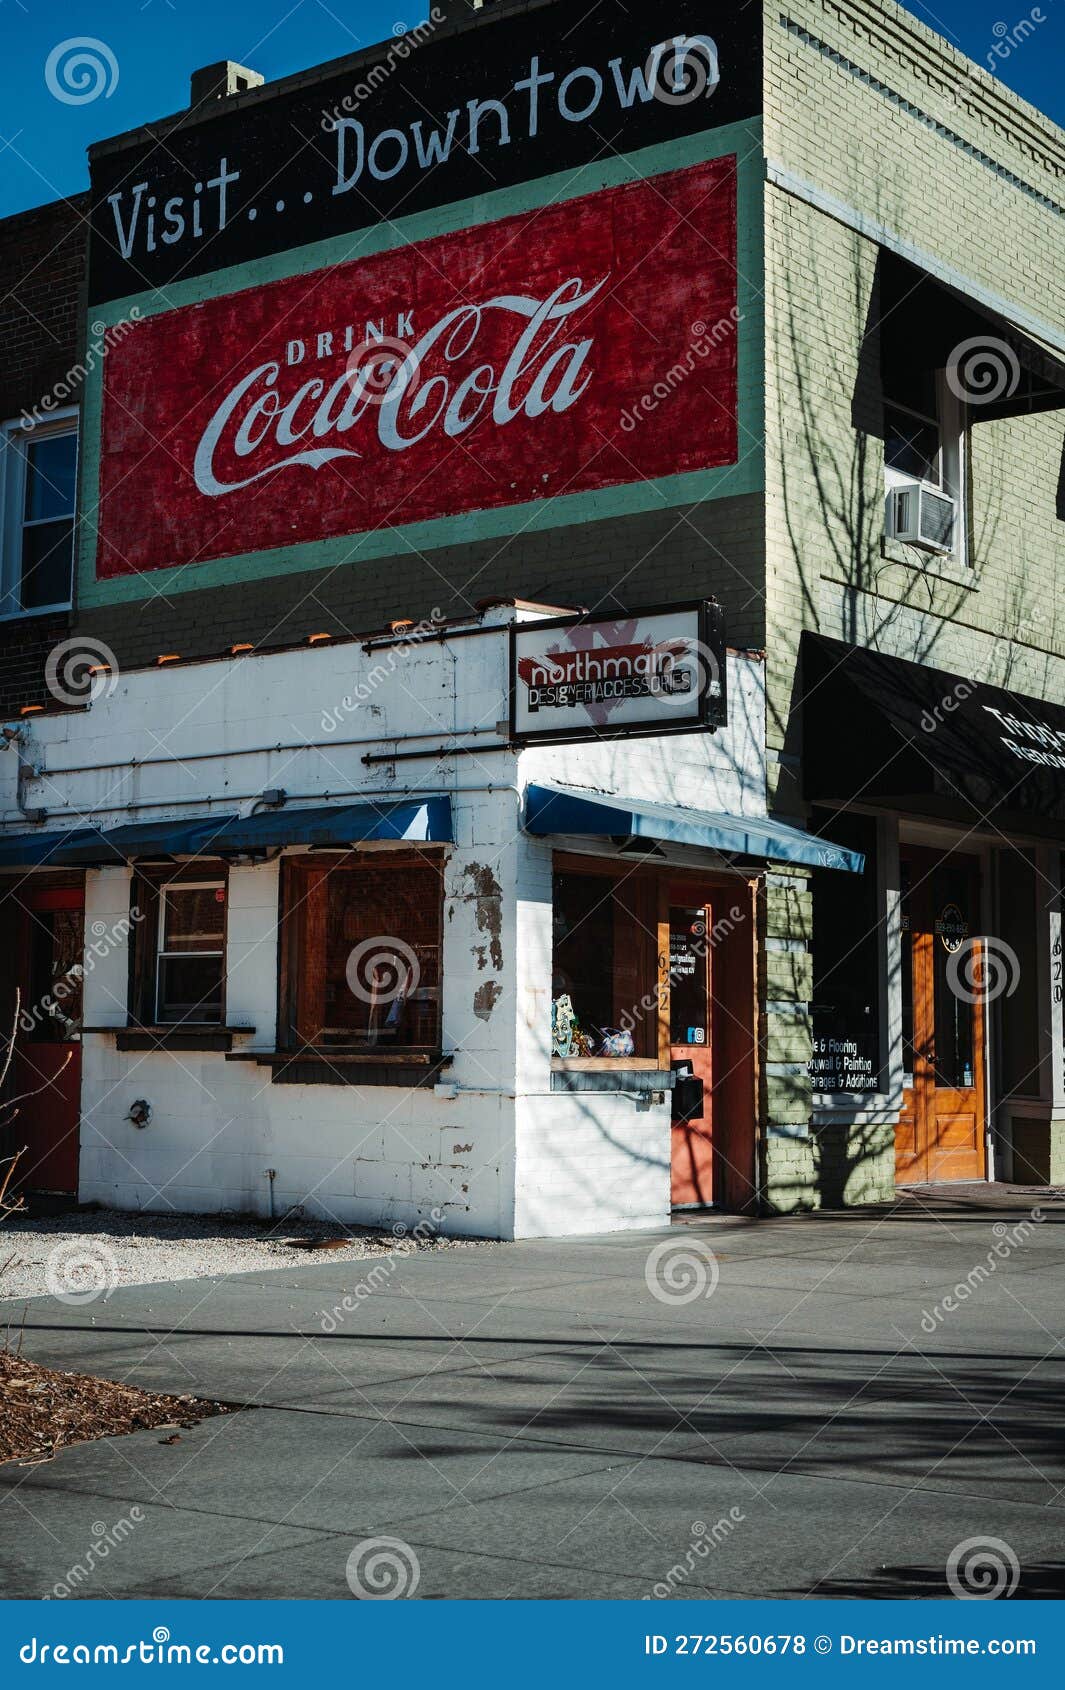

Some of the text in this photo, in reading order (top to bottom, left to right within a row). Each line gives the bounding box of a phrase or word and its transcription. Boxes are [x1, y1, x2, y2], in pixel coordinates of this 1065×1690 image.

[332, 33, 721, 196] Downtown
[286, 309, 416, 366] DRINK
[531, 652, 675, 686] northmain
[596, 672, 690, 699] ACCESSORIES
[1053, 935, 1062, 1003] 620
[829, 1038, 857, 1057] Flooring
[843, 1056, 871, 1074] Painting
[808, 1074, 836, 1090] arages
[845, 1073, 878, 1089] Additions
